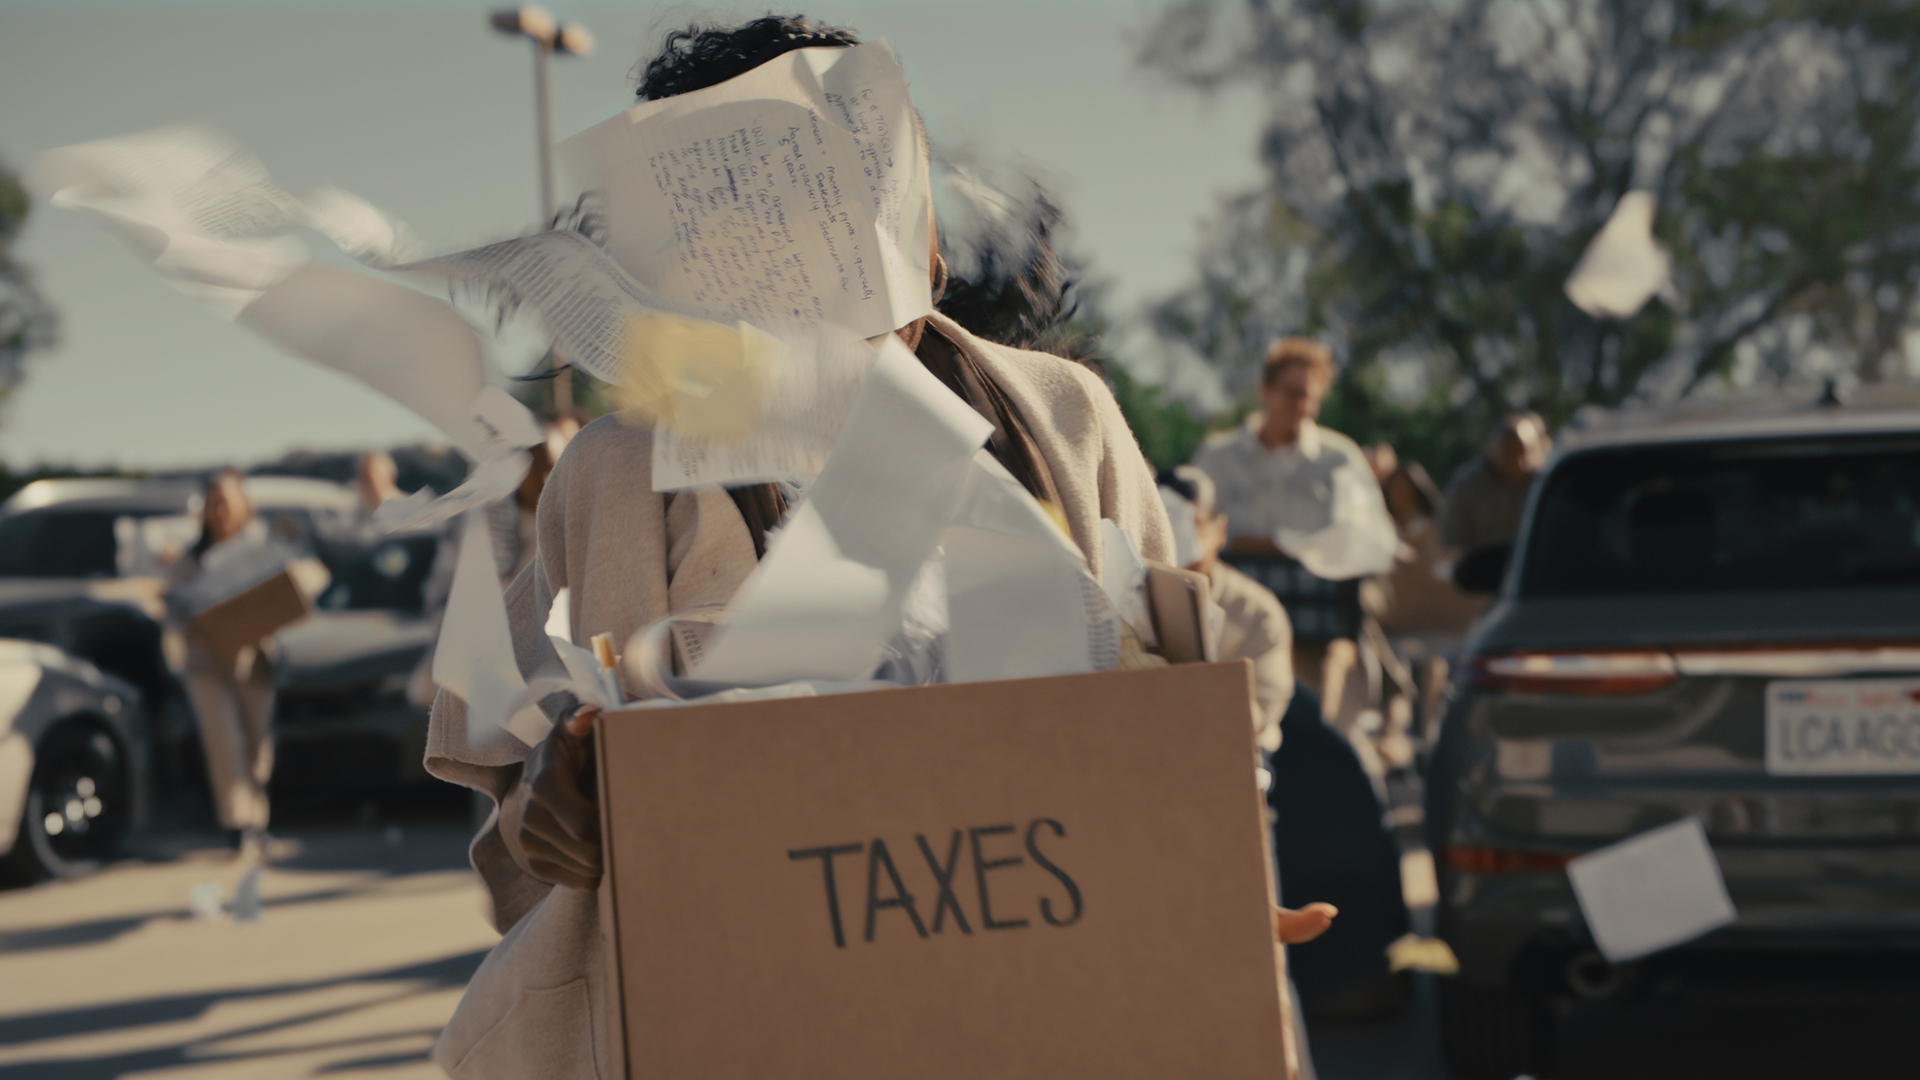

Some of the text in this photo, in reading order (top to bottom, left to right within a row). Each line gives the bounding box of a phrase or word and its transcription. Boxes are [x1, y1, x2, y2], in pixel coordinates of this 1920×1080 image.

[860, 87, 873, 100] For
[751, 125, 766, 147] Will
[759, 153, 771, 166] be
[765, 172, 775, 187] an
[780, 154, 798, 188] years.
[786, 126, 803, 160] Agreed
[796, 163, 819, 212] quarterly
[858, 148, 866, 161] to
[868, 184, 877, 192] a
[864, 141, 885, 180] approval
[814, 171, 837, 223] Statements
[826, 165, 842, 208] Monthly
[768, 195, 795, 243] agreement
[788, 818, 1083, 949] TAXES
